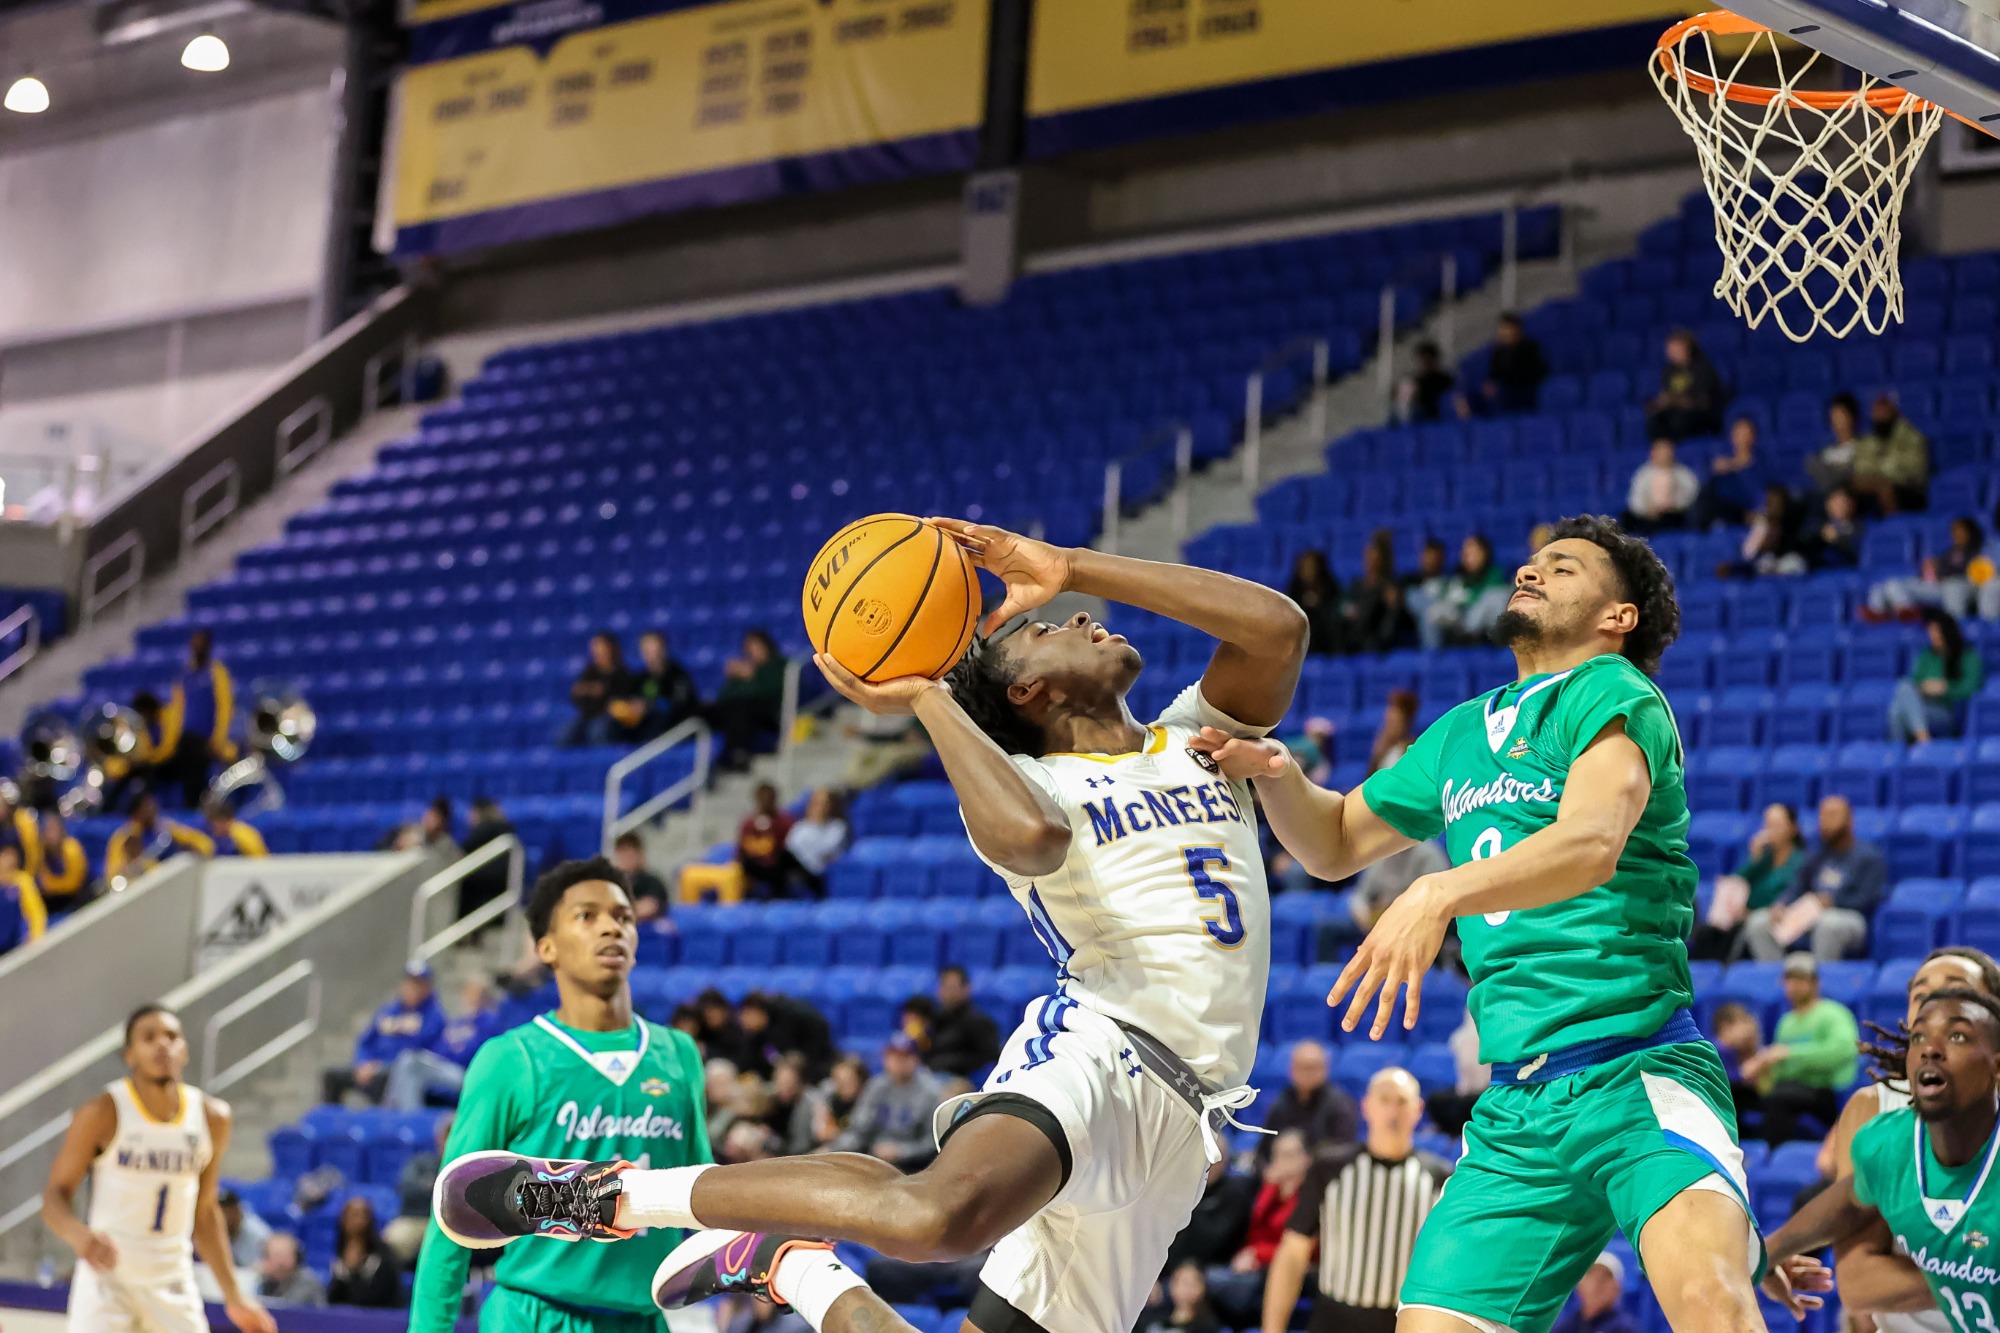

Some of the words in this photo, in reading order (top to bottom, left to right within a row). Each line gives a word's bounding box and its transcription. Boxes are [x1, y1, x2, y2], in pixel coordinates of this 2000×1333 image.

[811, 545, 850, 613] EVO
[849, 531, 868, 547] NXT
[1082, 781, 1246, 848] McNEES
[1179, 843, 1248, 950] 5
[153, 1183, 169, 1232] 1
[1939, 1286, 2000, 1333] 13
